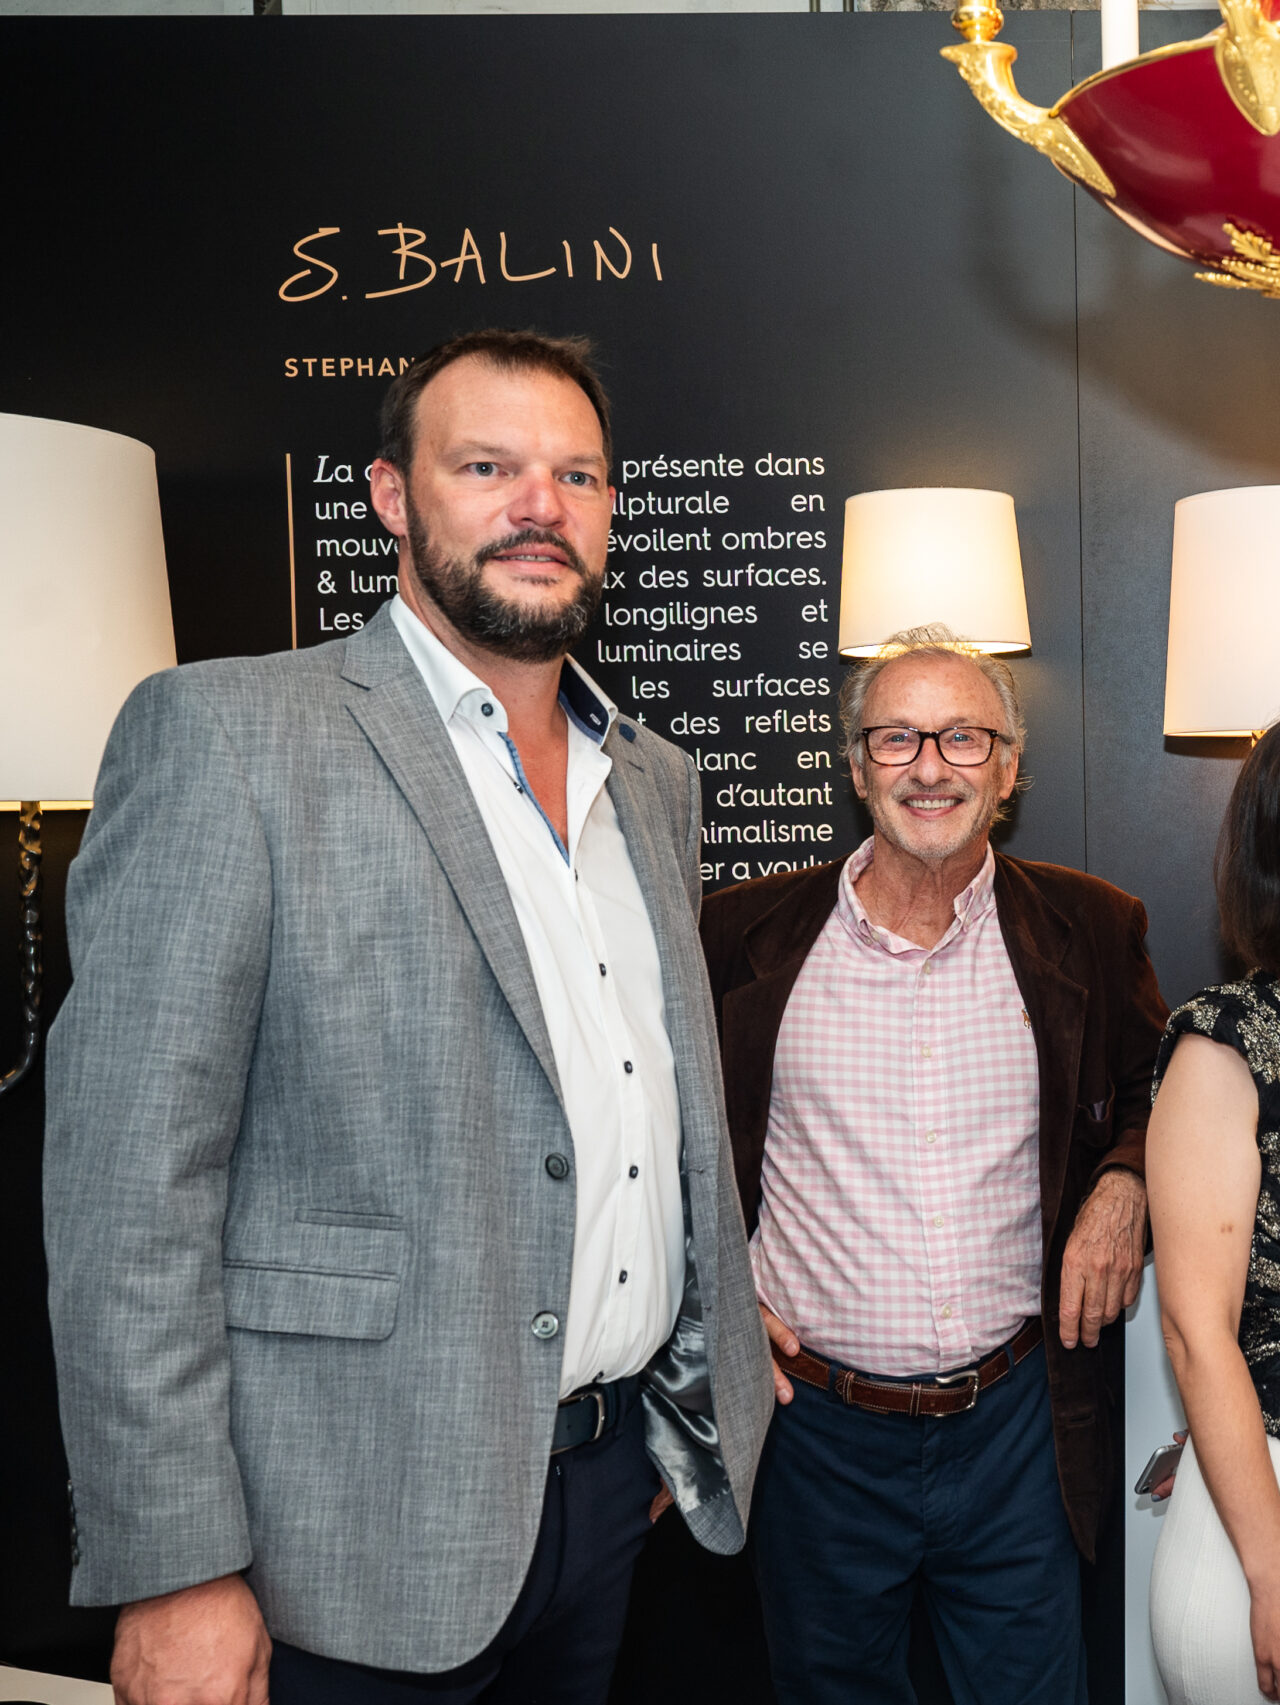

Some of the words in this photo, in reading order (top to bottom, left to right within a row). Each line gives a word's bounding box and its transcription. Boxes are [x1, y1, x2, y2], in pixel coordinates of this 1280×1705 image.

[284, 357, 413, 377] STEPHAN
[312, 455, 354, 483] La
[622, 453, 745, 484] présente
[754, 452, 825, 477] dans
[315, 501, 368, 520] une
[790, 493, 826, 513] en
[606, 526, 712, 552] évoilent
[721, 525, 827, 551] ombres
[317, 570, 337, 595] &
[350, 570, 399, 594] lum
[638, 564, 689, 589] des
[702, 562, 827, 588] surfaces.
[320, 608, 364, 630] Les
[605, 601, 758, 632] longilignes
[801, 598, 829, 623] et
[597, 638, 742, 663] luminaires
[798, 640, 829, 660] se
[631, 675, 670, 700] les
[712, 672, 831, 698] surfaces
[670, 711, 721, 735] des
[745, 708, 832, 734] reflets
[796, 750, 832, 770] en
[700, 820, 833, 844] nimalisme
[731, 861, 751, 880] a
